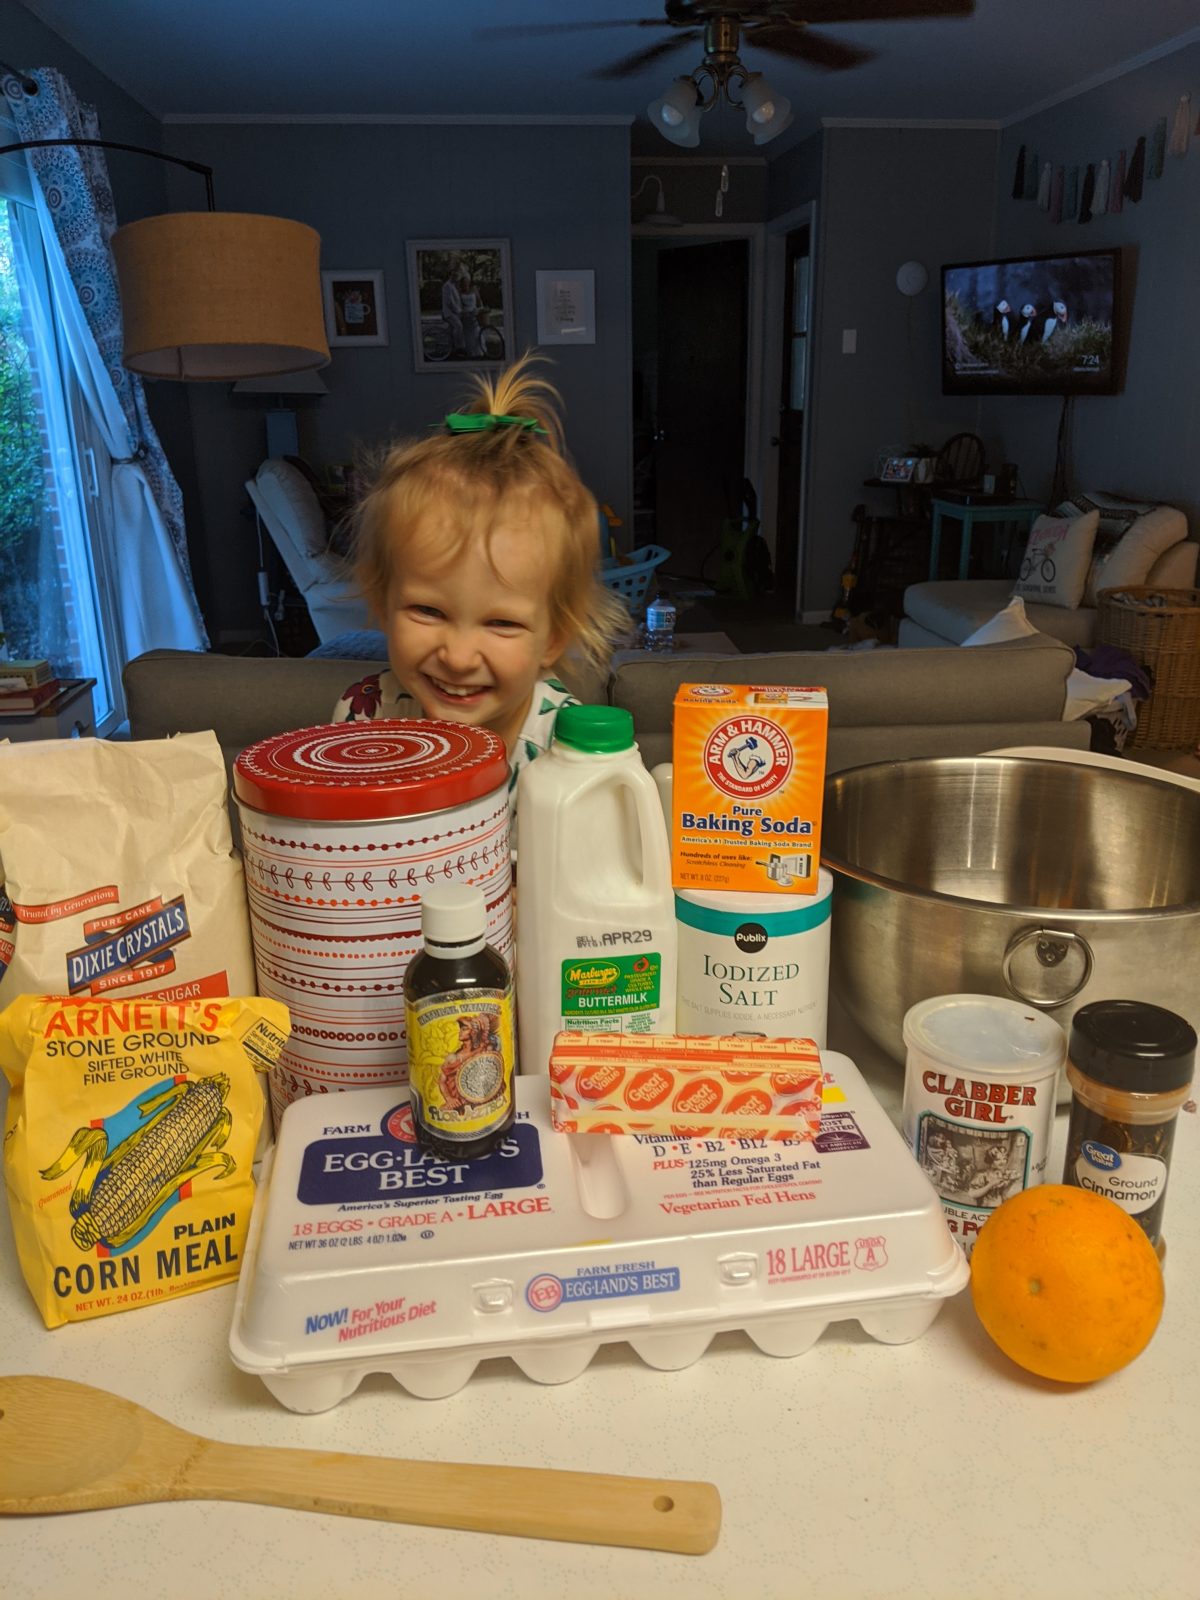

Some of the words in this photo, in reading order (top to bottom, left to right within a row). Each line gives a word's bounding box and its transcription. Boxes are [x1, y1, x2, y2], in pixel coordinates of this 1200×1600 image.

[708, 732, 730, 765] ARM
[727, 723, 738, 736] &
[740, 719, 788, 767] HAMMER
[732, 806, 762, 817] Pure
[682, 813, 754, 835] Baking
[760, 817, 812, 835] Soda
[680, 851, 712, 860] Hundreds
[51, 904, 62, 918] by
[64, 890, 115, 912] Generations
[92, 917, 122, 931] PURE
[125, 906, 152, 921] CANE
[72, 945, 115, 984] DIXIE
[117, 908, 185, 964] CRYSTALS
[736, 932, 766, 943] Publix
[99, 973, 134, 989] SINCE
[139, 965, 166, 979] 1917
[704, 954, 800, 982] IODIZED
[158, 984, 201, 1003] SUGAR
[578, 992, 647, 1008] BUTTERMILK
[719, 982, 778, 1006] SALT
[44, 1002, 223, 1040] ARNETT'S
[46, 1038, 116, 1058] STONE
[123, 1031, 221, 1051] GROUND
[88, 1056, 136, 1073] SIFTED
[140, 1051, 184, 1065] WHITE
[84, 1073, 116, 1086] FINE
[120, 1063, 190, 1080] GROUND
[594, 1070, 621, 1091] Value
[628, 1072, 664, 1102] Great
[643, 1080, 669, 1102] Value
[677, 1083, 713, 1112] Great
[922, 1070, 1037, 1106] CLABBER
[690, 1092, 718, 1113] Value
[728, 1095, 761, 1115] reat
[944, 1097, 1010, 1124] GIRL
[322, 1124, 371, 1136] FARM
[633, 1133, 692, 1145] Vitamins
[653, 1145, 666, 1157] D
[681, 1143, 692, 1155] E
[706, 1141, 725, 1153] B2
[739, 1138, 768, 1150] B12
[1085, 1143, 1115, 1163] Great
[652, 1159, 685, 1171] PLUS
[689, 1157, 727, 1170] 125mg
[730, 1154, 770, 1167] Omega
[774, 1153, 782, 1163] 3
[690, 1167, 715, 1179] 25%
[718, 1165, 745, 1177] Less
[746, 1161, 800, 1174] Saturated
[802, 1160, 822, 1170] Fat
[1091, 1155, 1114, 1168] Value
[379, 1164, 470, 1190] BEST
[692, 1177, 718, 1189] than
[721, 1174, 764, 1188] Regular
[768, 1172, 795, 1184] Eggs
[1108, 1176, 1159, 1189] Ground
[1081, 1176, 1156, 1201] Cinnamon
[337, 1200, 391, 1212] America's
[393, 1196, 439, 1210] Superior
[443, 1193, 482, 1206] Tasting
[484, 1191, 504, 1201] Egg
[660, 1197, 741, 1216] Vegetarian
[742, 1192, 772, 1207] Fed
[774, 1190, 817, 1203] Hens
[173, 1212, 236, 1240] PLAIN
[292, 1224, 313, 1237] 18
[316, 1219, 364, 1235] EGGS
[378, 1212, 438, 1230] GRADE
[440, 1210, 454, 1224] A
[467, 1197, 553, 1221] LARGE
[288, 1241, 304, 1251] NET
[304, 1240, 318, 1249] WT
[318, 1239, 328, 1248] 36
[328, 1238, 339, 1248] OZ
[348, 1236, 363, 1246] LBS
[366, 1236, 371, 1244] 4
[53, 1255, 140, 1298] CORN
[156, 1234, 239, 1280] MEAL
[766, 1248, 787, 1276] 18
[791, 1241, 851, 1273] LARGE
[866, 1248, 877, 1262] A
[576, 1265, 611, 1276] FARM
[614, 1260, 656, 1273] FRESH
[642, 1272, 678, 1290] BEST
[75, 1302, 94, 1313] NET
[117, 1294, 129, 1304] 24
[305, 1308, 349, 1334] NOW!
[351, 1307, 373, 1324] For
[374, 1297, 405, 1317] Your
[338, 1312, 406, 1343] Nutritious
[407, 1300, 438, 1321] Diet
